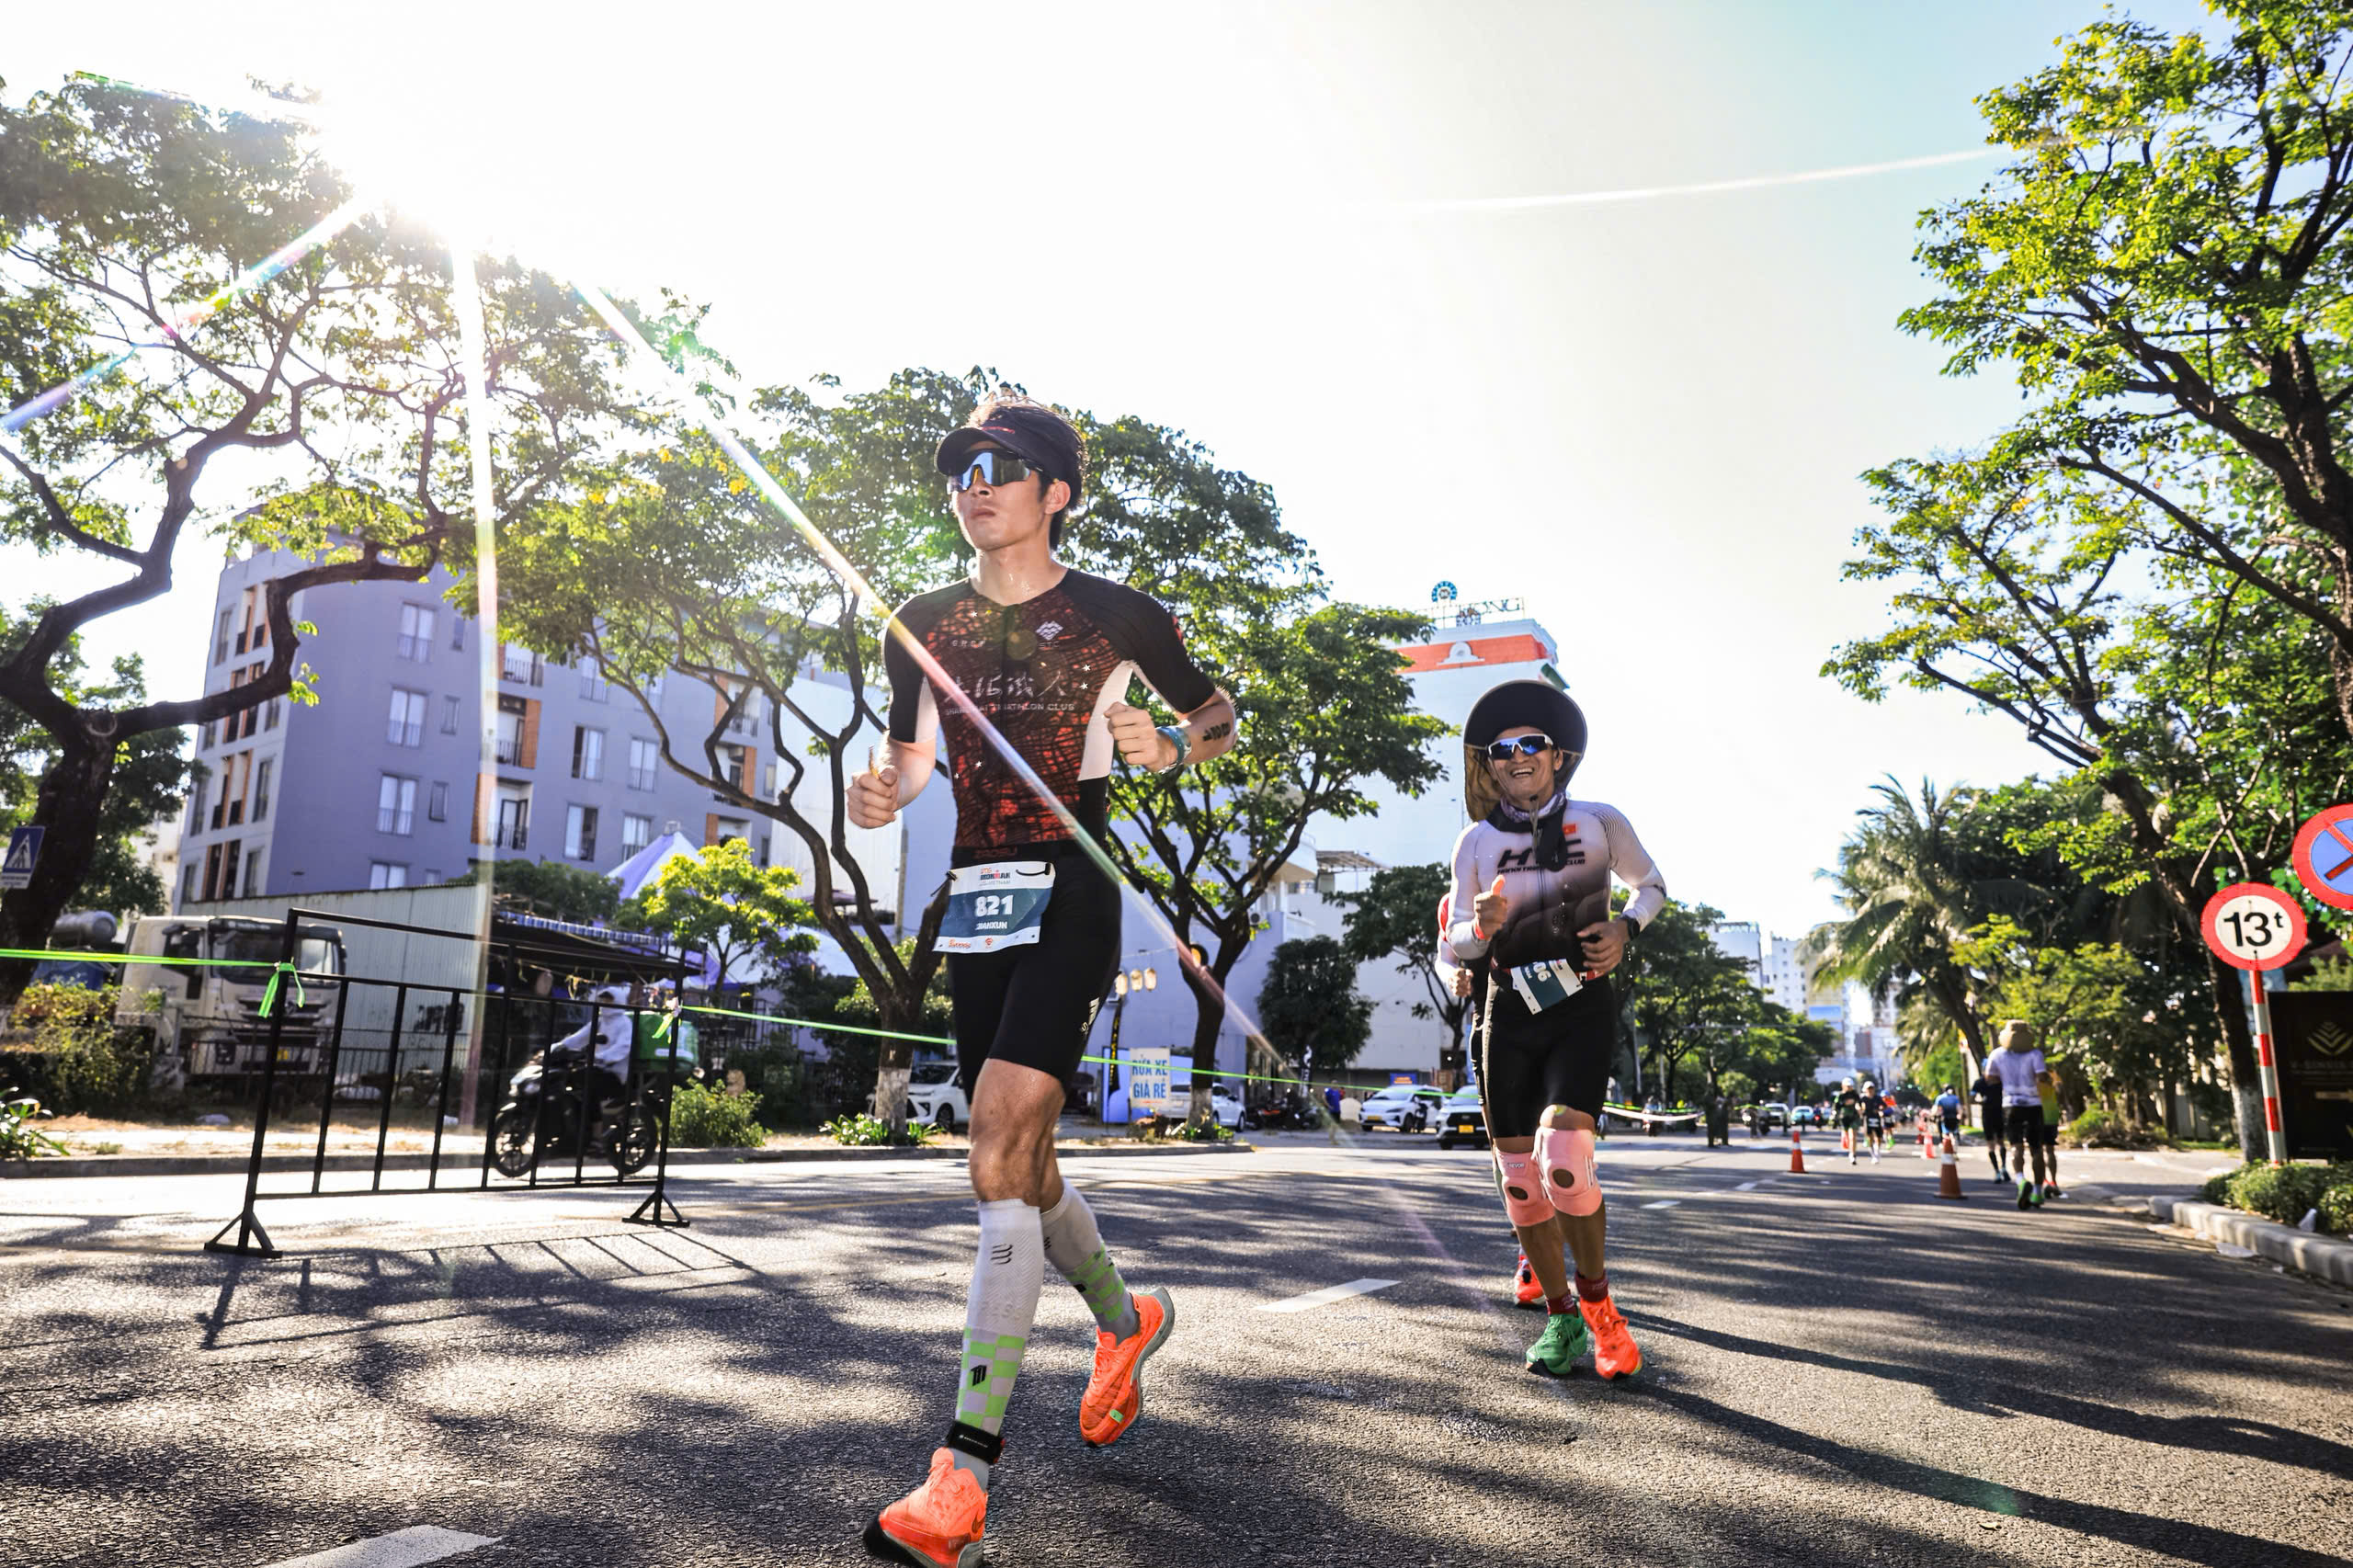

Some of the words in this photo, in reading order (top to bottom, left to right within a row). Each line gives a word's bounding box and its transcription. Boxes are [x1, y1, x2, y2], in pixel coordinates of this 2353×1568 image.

[1047, 702, 1074, 710] CLUB
[975, 894, 1014, 917] 821
[1532, 961, 1552, 982] 06
[1155, 1060, 1168, 1075] XE
